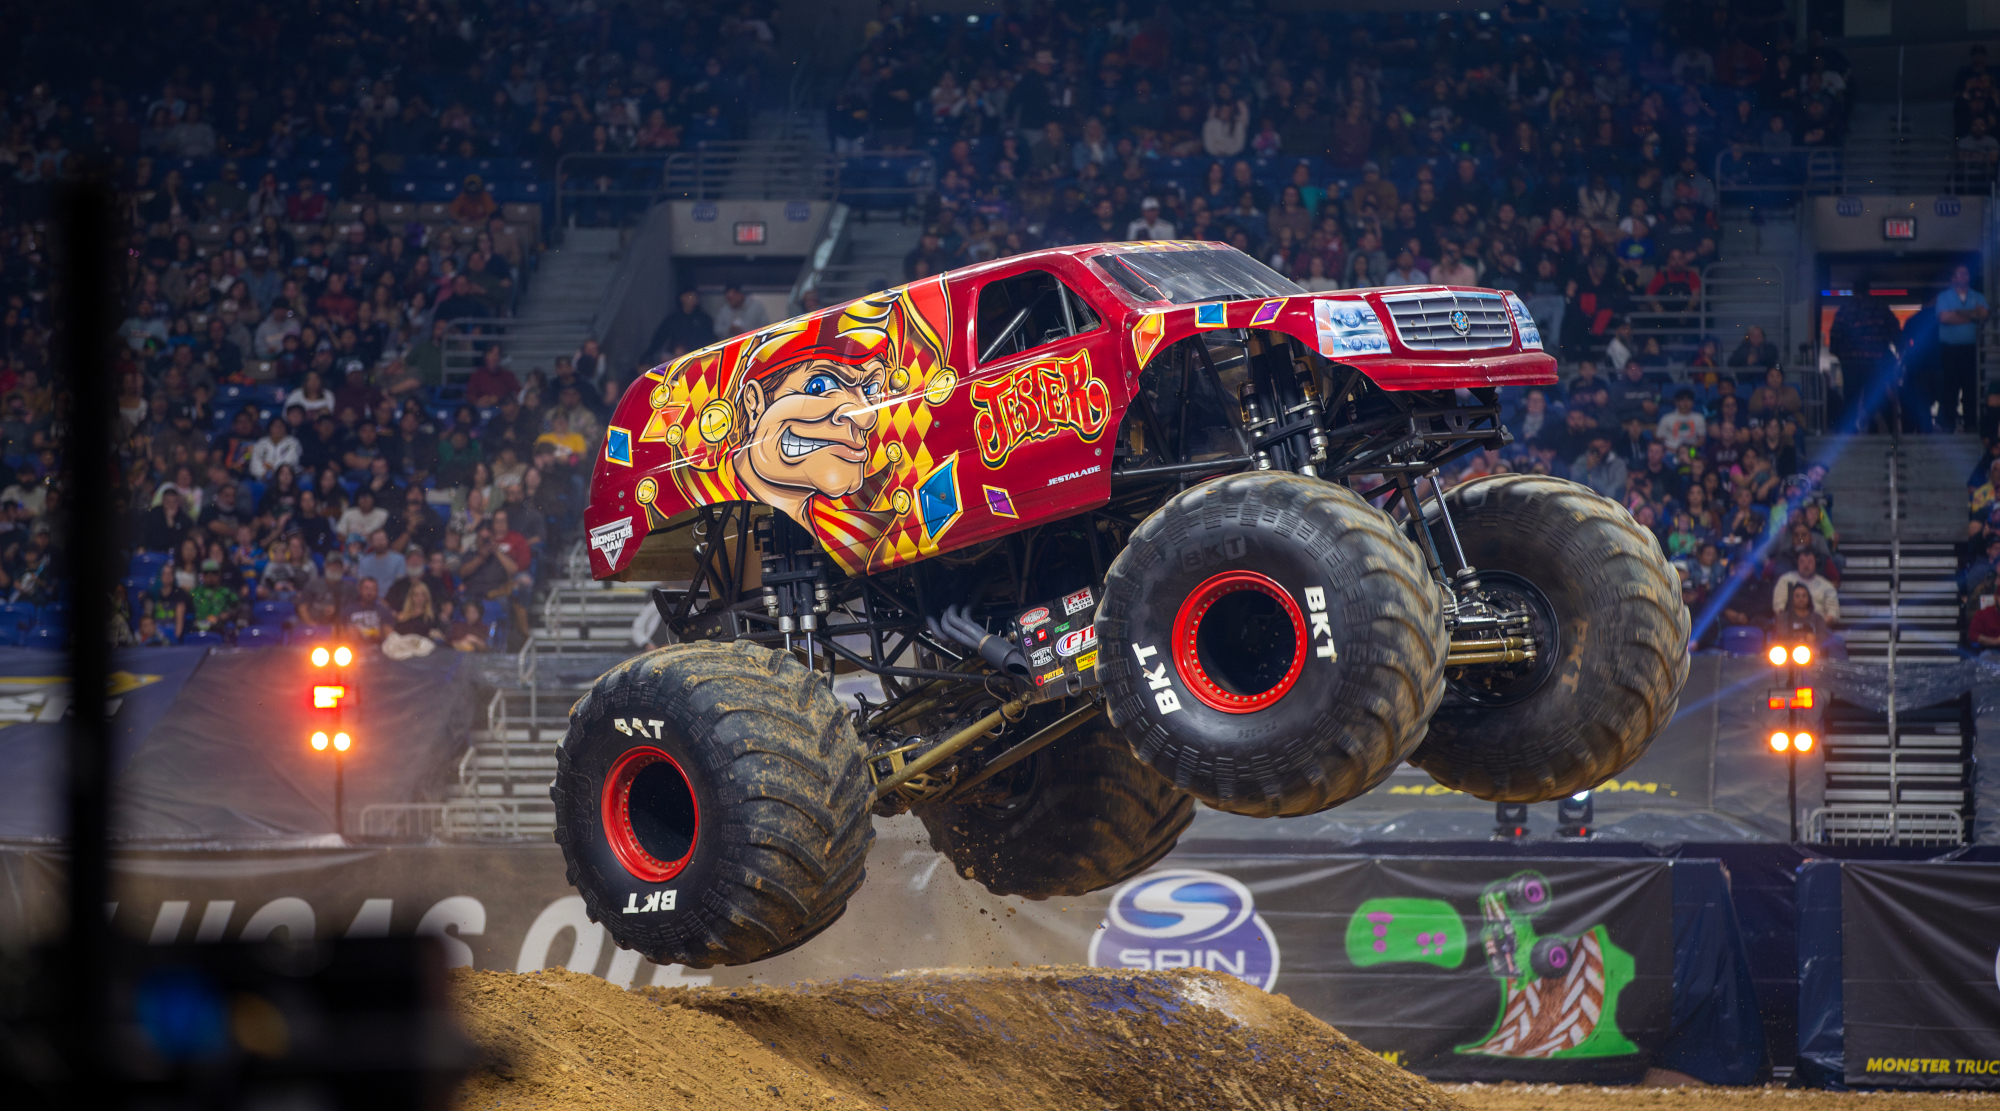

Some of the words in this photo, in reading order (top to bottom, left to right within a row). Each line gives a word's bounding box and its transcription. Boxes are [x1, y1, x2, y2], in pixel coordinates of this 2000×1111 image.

[971, 349, 1110, 468] JESTER
[1047, 465, 1101, 486] JESTALADE
[591, 525, 633, 550] MONSTER
[604, 538, 623, 553] JAM
[1304, 586, 1337, 659] BKT
[1067, 626, 1094, 649] FTI
[1131, 643, 1182, 715] BKT
[623, 889, 678, 914] BKT
[1119, 949, 1246, 975] SPIN
[1866, 1057, 1951, 1074] MONSTER
